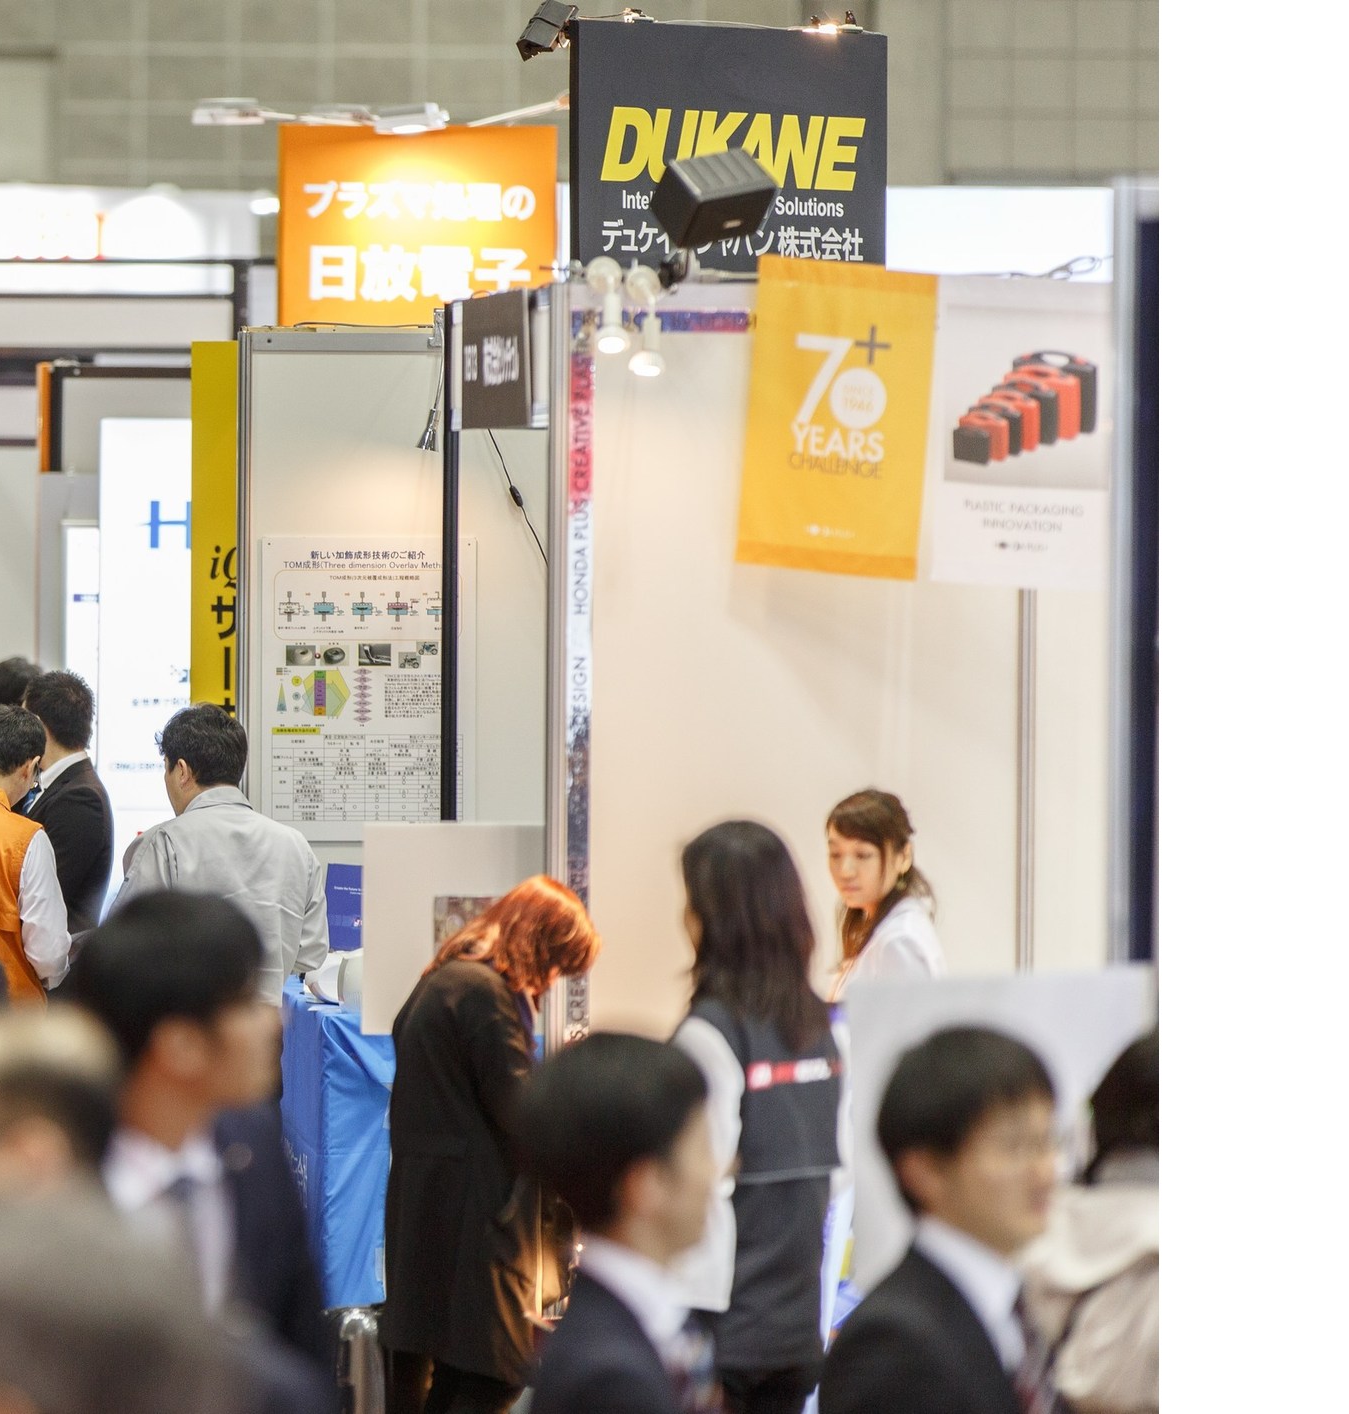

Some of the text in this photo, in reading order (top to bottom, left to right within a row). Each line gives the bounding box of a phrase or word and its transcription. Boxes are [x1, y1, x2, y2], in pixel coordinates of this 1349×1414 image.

[600, 106, 866, 192] DUKANE
[775, 196, 845, 218] Solutions
[572, 408, 590, 492] CREATIVE
[791, 420, 886, 464] YEARS
[573, 498, 590, 540] PLUS
[348, 561, 387, 569] dimension
[388, 561, 419, 570] Overlay
[421, 561, 442, 569] Meth
[573, 547, 589, 615] HONDA
